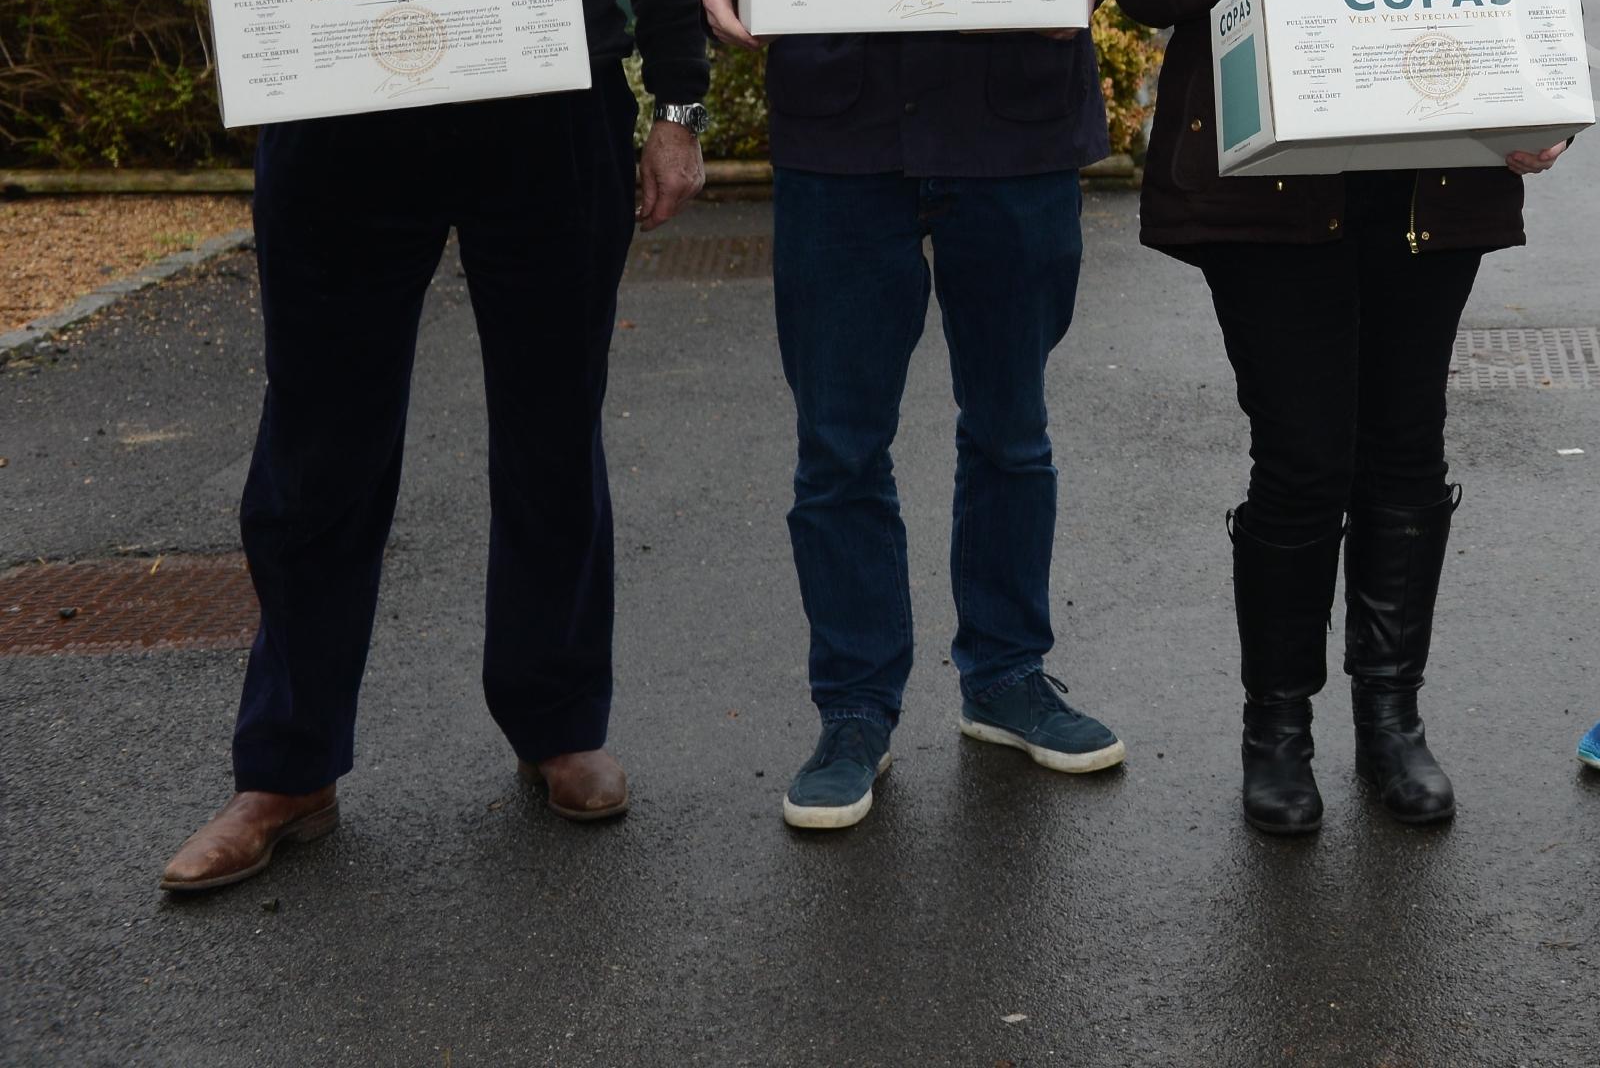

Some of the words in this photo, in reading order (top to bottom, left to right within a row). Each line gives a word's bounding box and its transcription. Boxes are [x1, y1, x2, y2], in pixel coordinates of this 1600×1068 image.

[1347, 15, 1377, 24] VERY
[1380, 13, 1409, 23] VERY
[1413, 12, 1460, 22] SPECIAL
[1462, 9, 1512, 19] TURKEYS
